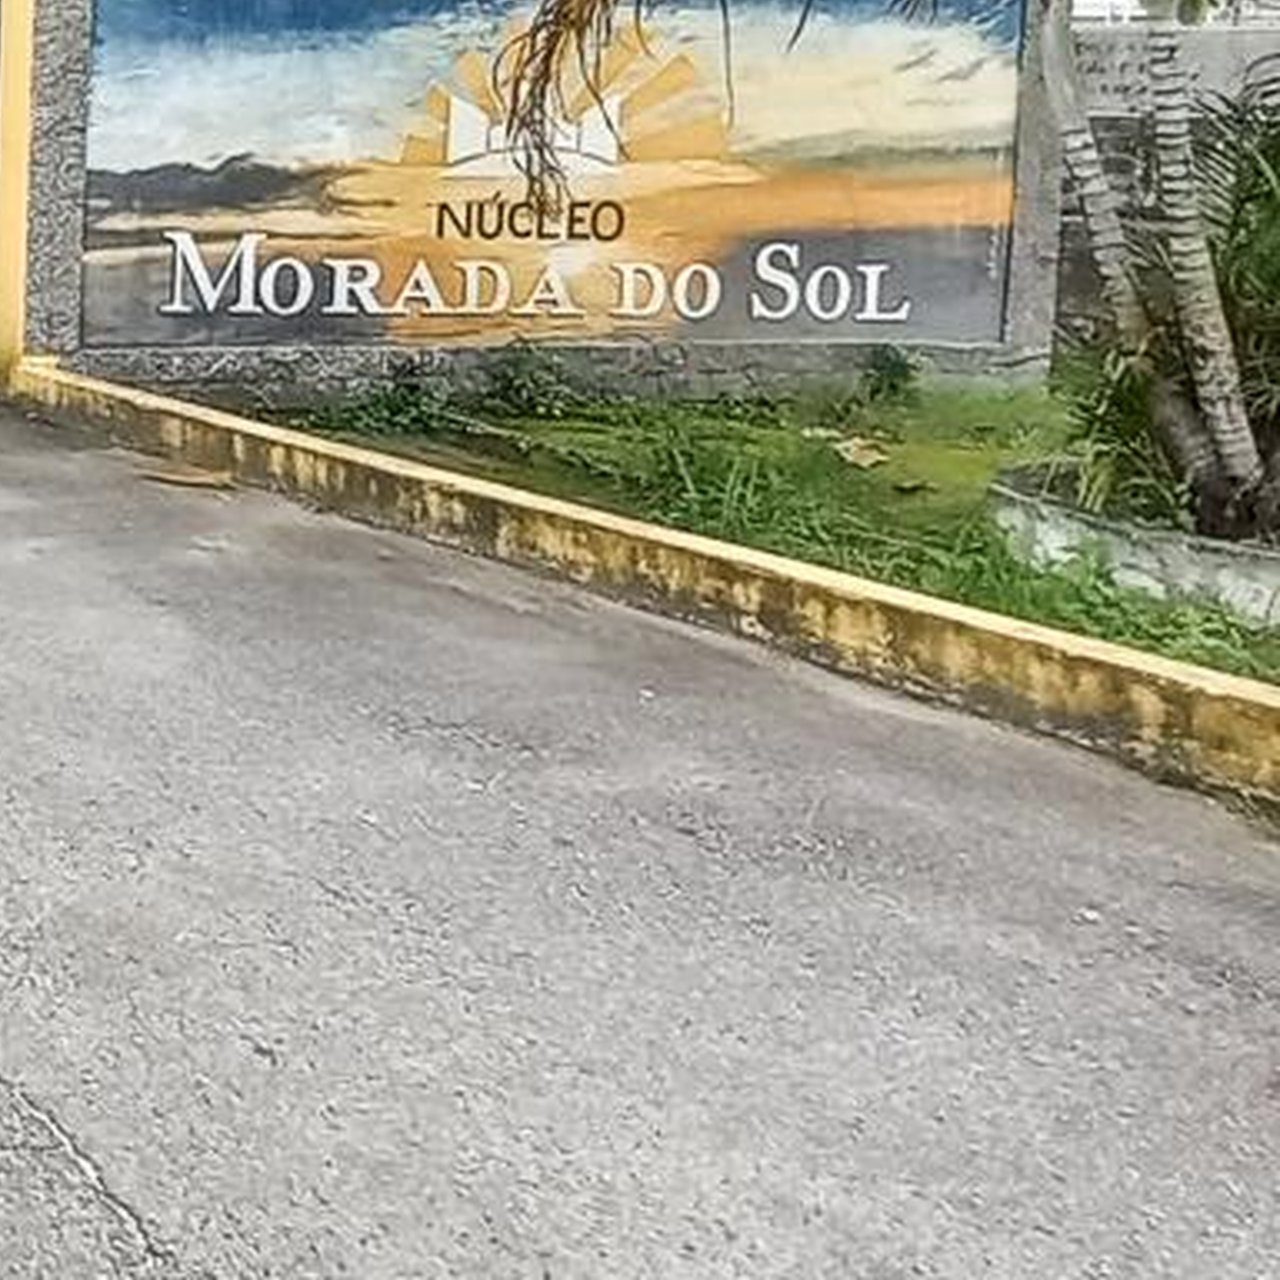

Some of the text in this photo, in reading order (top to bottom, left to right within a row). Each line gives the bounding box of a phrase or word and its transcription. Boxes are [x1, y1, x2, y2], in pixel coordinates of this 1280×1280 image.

[436, 190, 625, 242] NÚCLEO
[159, 230, 584, 317] MORADA
[612, 261, 721, 319] DO
[751, 241, 911, 321] SOL
